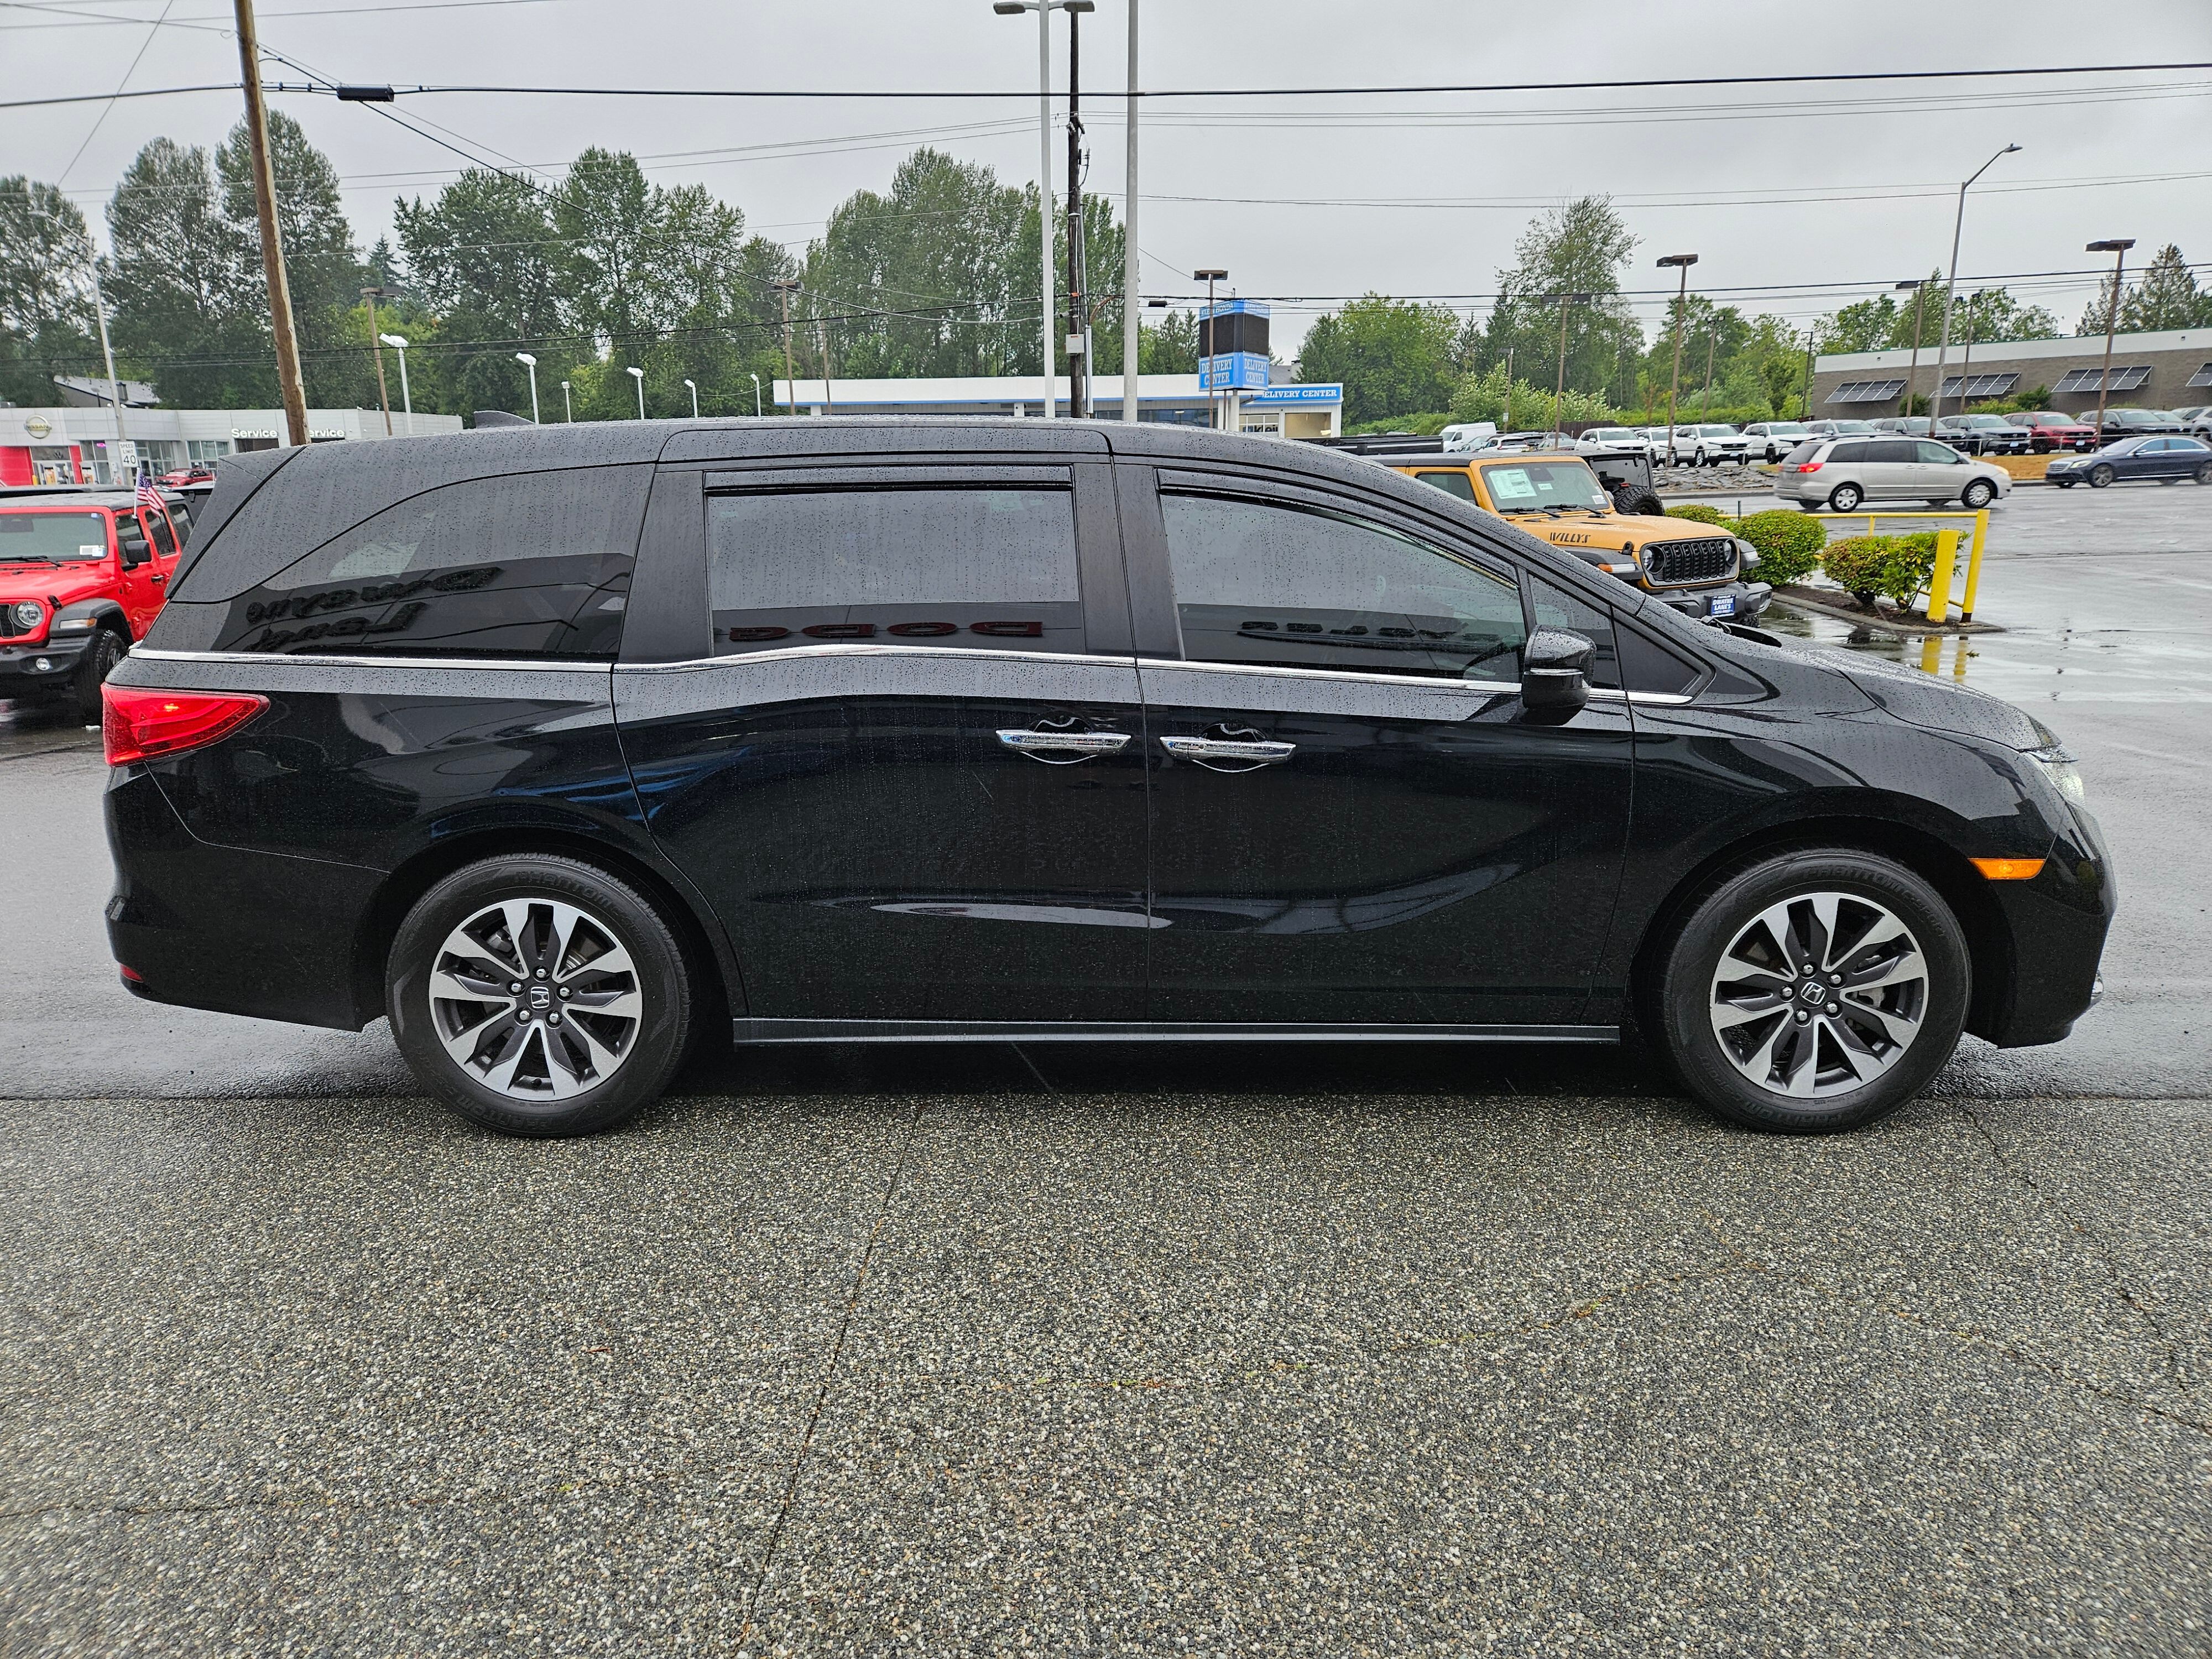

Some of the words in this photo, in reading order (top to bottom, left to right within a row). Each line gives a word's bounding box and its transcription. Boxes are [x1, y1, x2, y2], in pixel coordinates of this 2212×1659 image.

[1201, 358, 1233, 374] DEIVERY
[1244, 358, 1267, 372] DELIVERY
[1204, 372, 1230, 385] CNTER
[1246, 372, 1265, 384] CENTER
[231, 428, 278, 438] Service
[309, 429, 345, 437] ervice
[123, 455, 136, 464] 40
[1550, 532, 1591, 543] WILLYS
